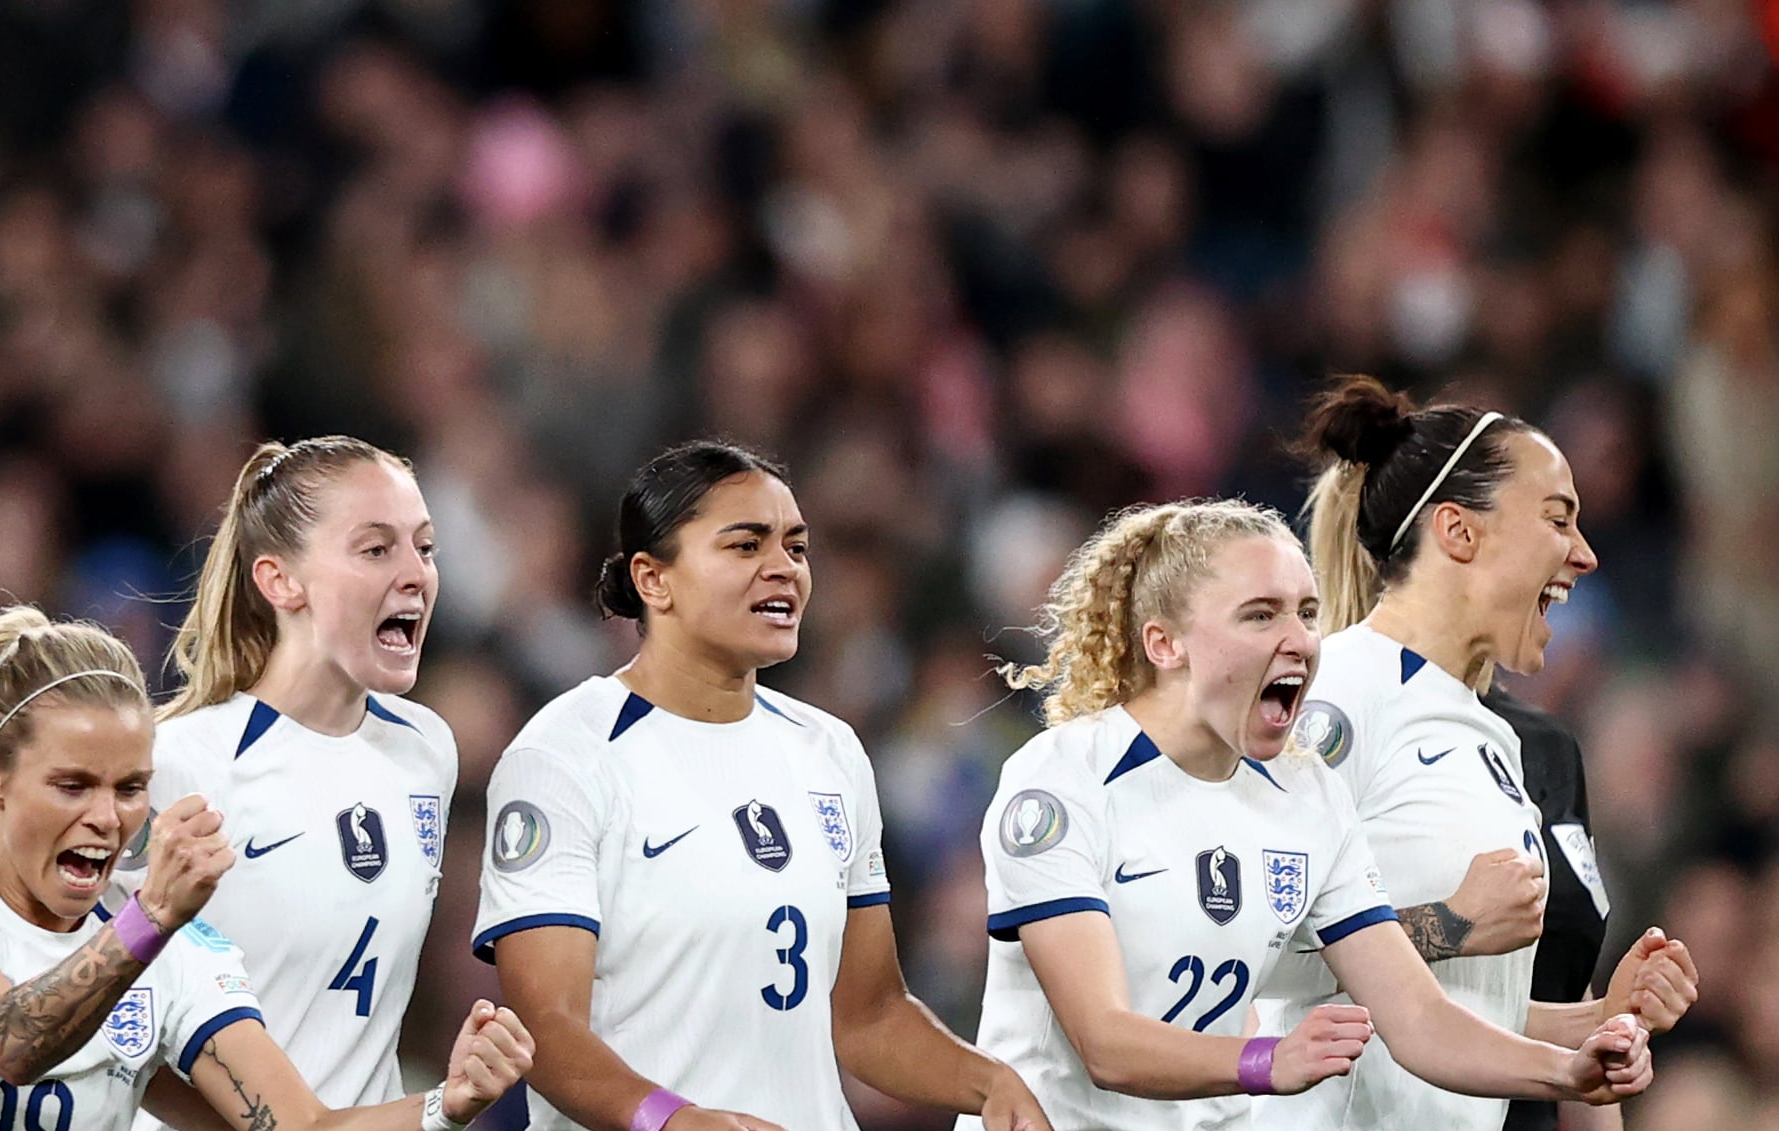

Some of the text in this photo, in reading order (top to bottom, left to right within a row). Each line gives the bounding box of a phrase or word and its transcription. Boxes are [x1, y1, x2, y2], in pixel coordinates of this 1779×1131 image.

[327, 915, 380, 1017] 4
[760, 905, 808, 1011] 3
[1161, 955, 1249, 1034] 22
